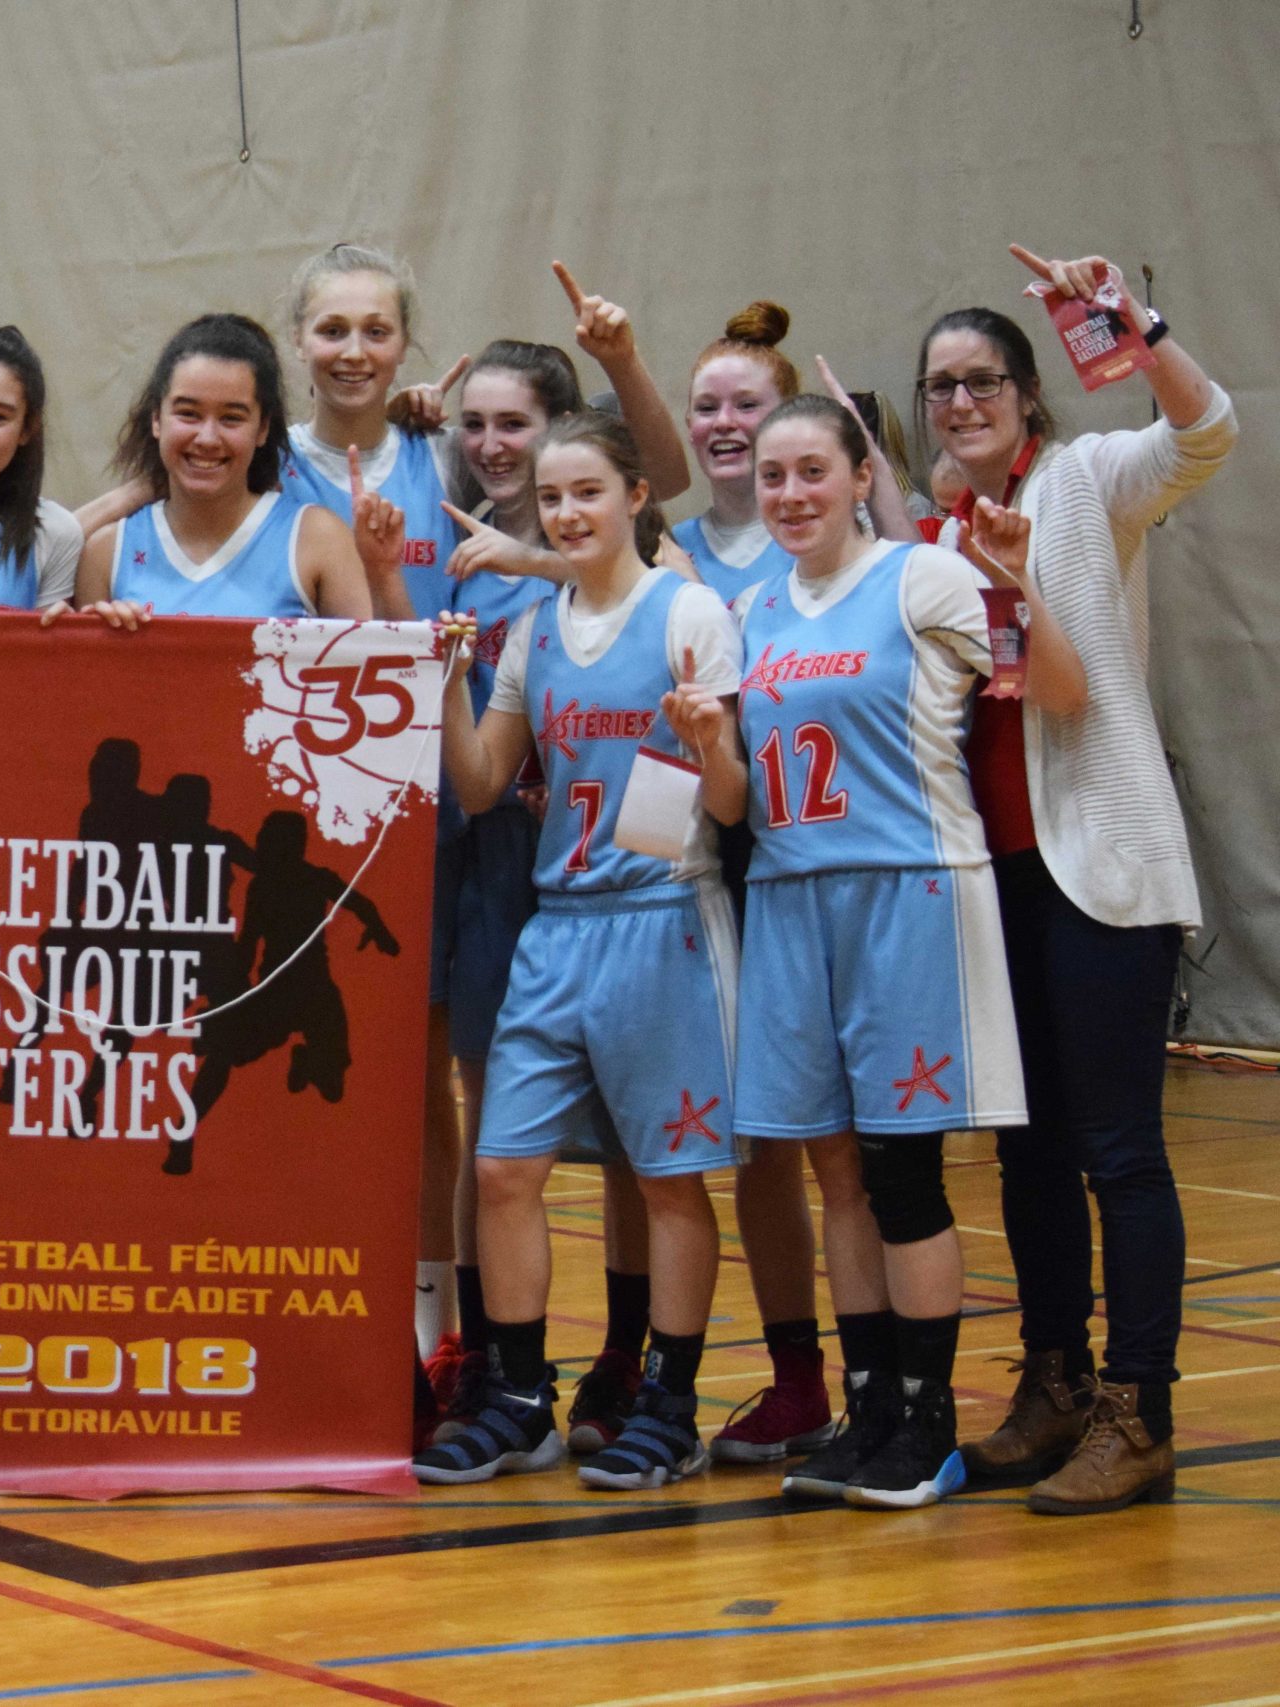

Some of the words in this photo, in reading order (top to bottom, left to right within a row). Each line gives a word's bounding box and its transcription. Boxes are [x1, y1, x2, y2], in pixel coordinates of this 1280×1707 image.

[400, 538, 437, 567] IES
[293, 655, 415, 756] 35
[397, 670, 418, 679] ANS
[756, 721, 848, 829] 12
[565, 780, 605, 873] 7
[170, 1238, 360, 1276] FÉMININ
[145, 1285, 272, 1315] CADET
[282, 1288, 369, 1317] AAA
